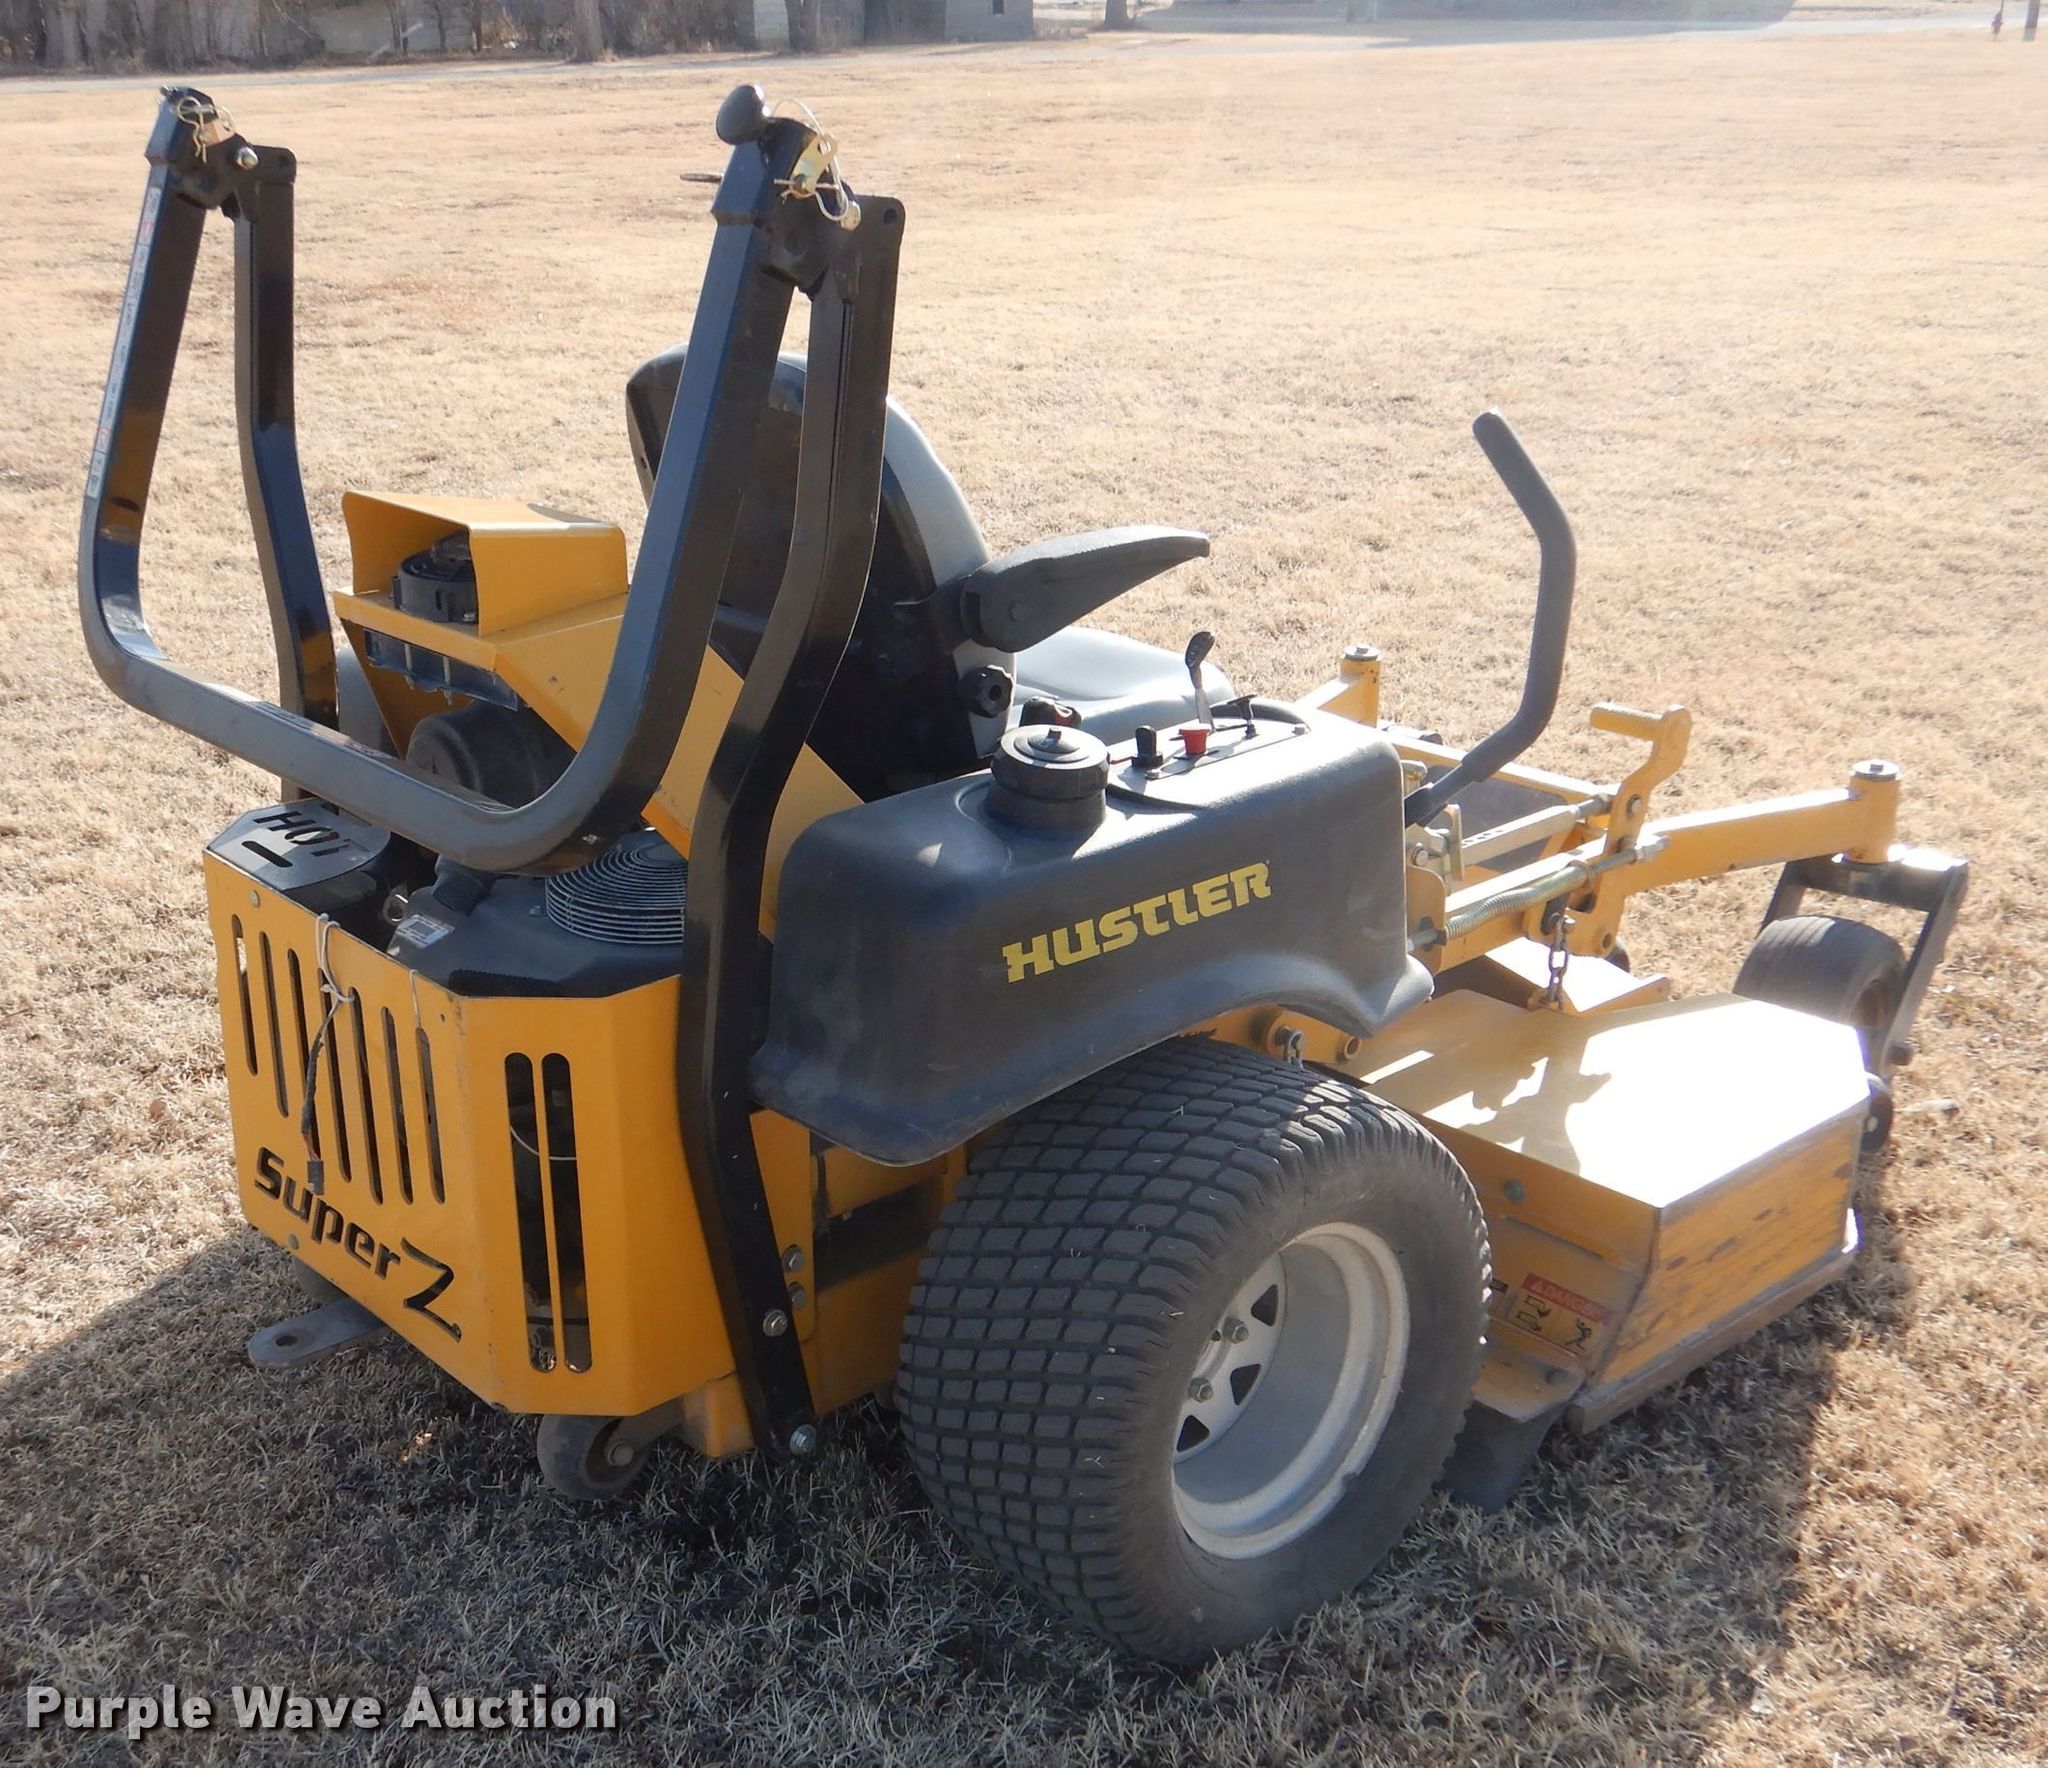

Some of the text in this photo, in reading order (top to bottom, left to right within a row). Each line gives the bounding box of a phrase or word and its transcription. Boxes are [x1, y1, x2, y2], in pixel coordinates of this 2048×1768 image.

[1002, 862, 1271, 984] HUSTLER
[254, 1147, 462, 1343] Super Z
